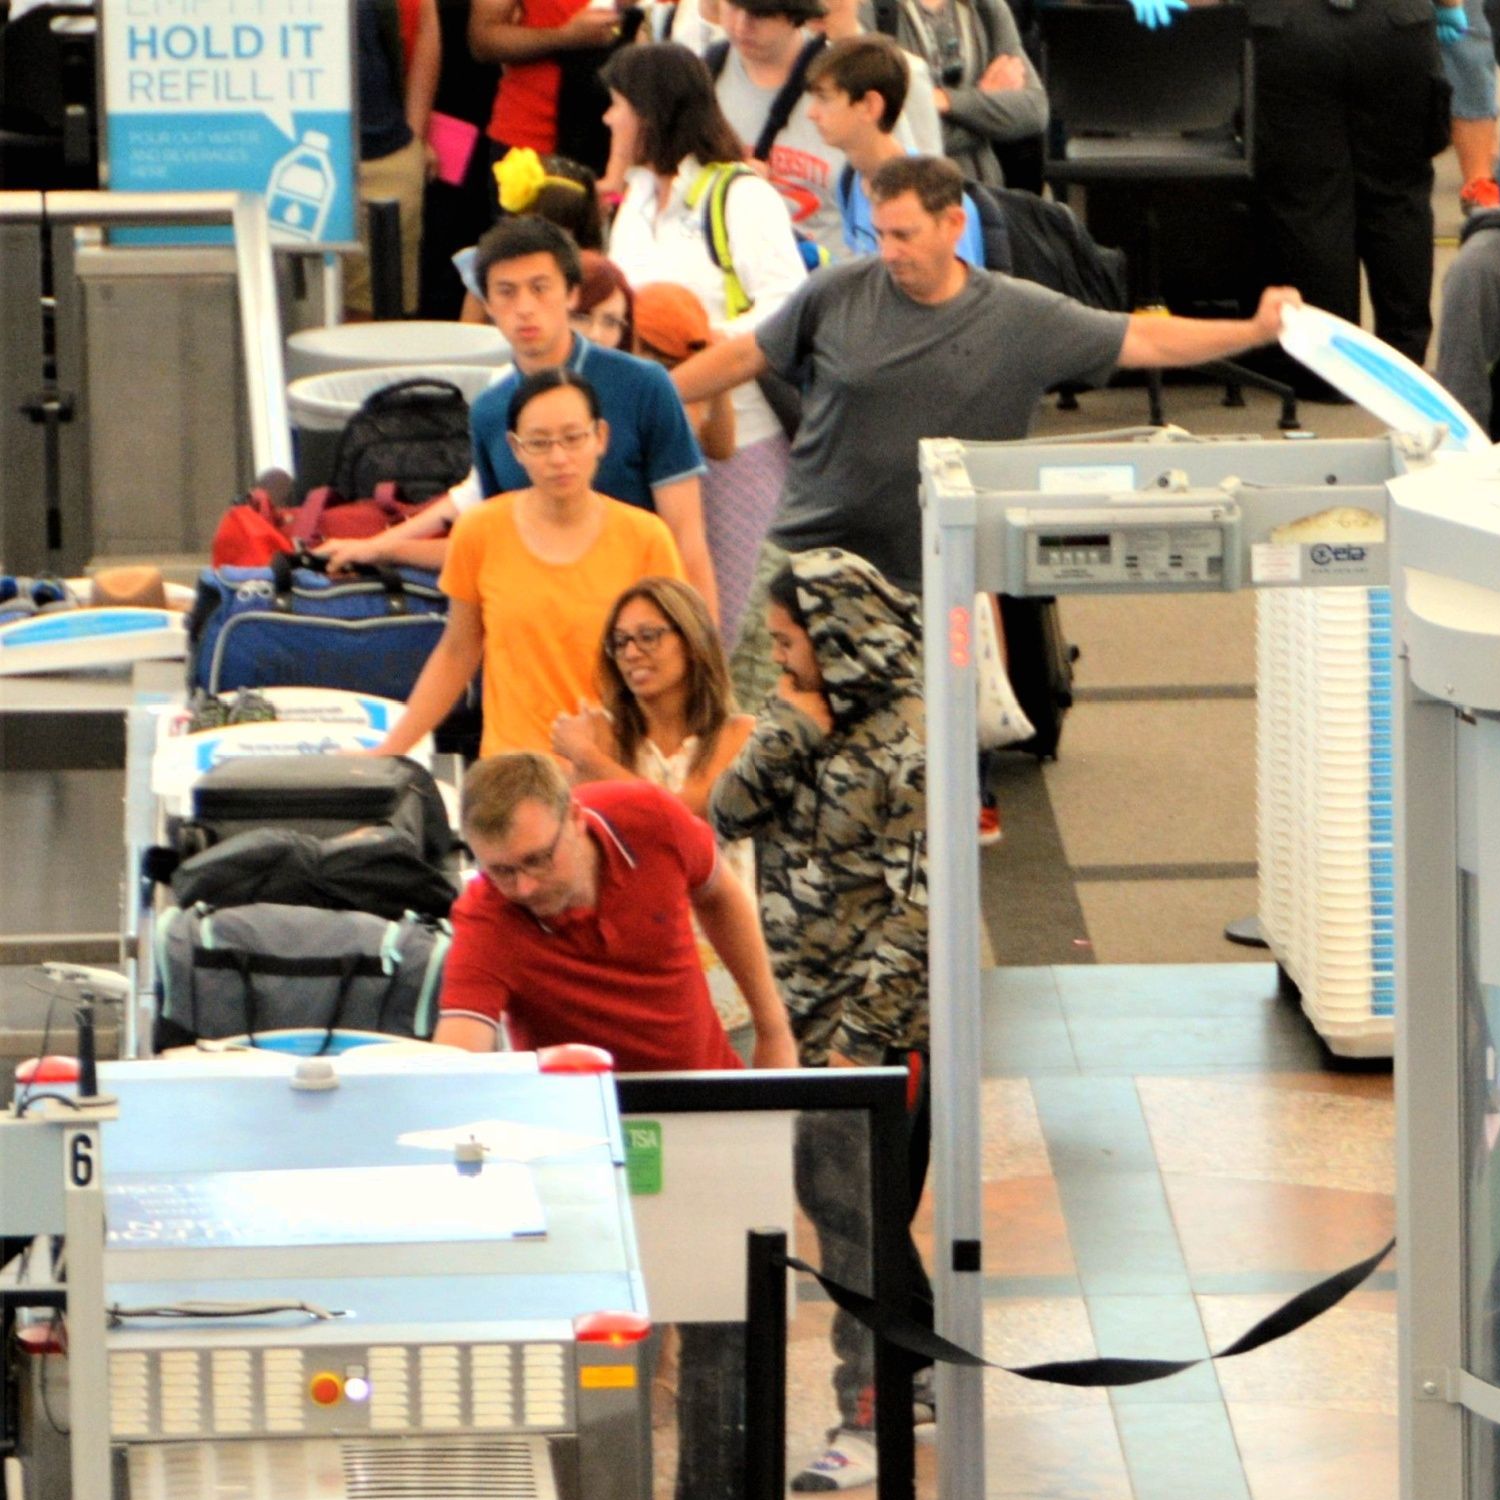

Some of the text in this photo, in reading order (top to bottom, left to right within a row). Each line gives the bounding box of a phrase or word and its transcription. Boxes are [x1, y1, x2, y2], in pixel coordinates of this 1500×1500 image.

[127, 23, 324, 60] HOLD IT
[128, 67, 324, 101] REFILL IT
[70, 1132, 94, 1187] 6
